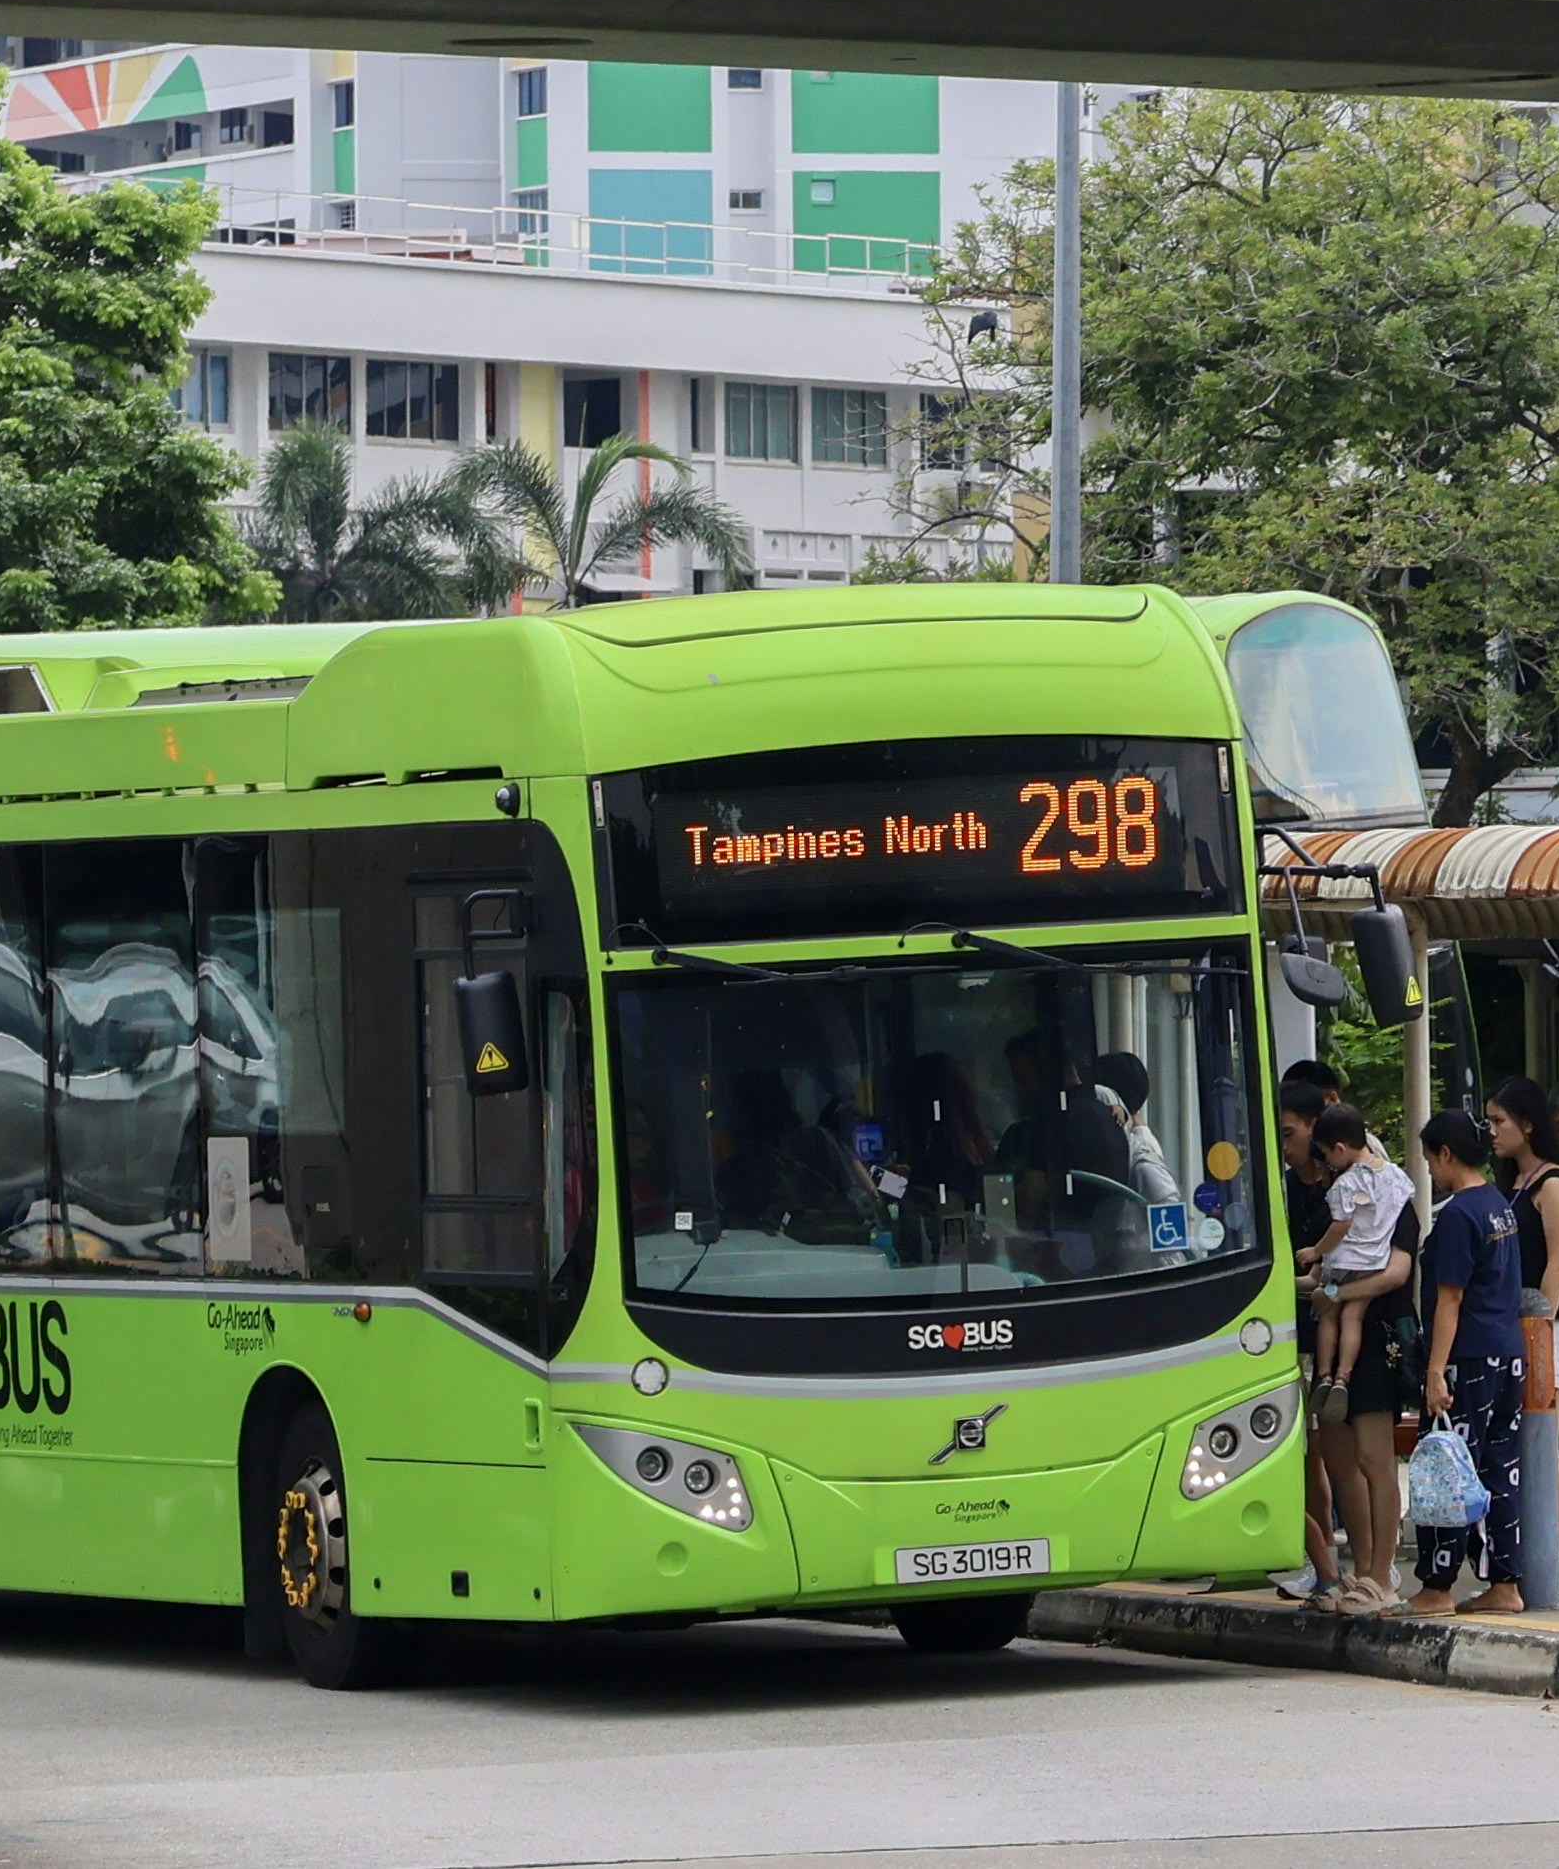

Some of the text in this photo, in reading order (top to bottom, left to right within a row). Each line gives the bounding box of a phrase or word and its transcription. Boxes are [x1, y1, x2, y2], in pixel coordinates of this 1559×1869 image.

[685, 812, 988, 866] Tampines North
[1018, 777, 1159, 873] 298
[207, 1302, 261, 1330] Go-Ahead
[224, 1331, 264, 1356] Singapore
[908, 1319, 1014, 1349] SG BUS
